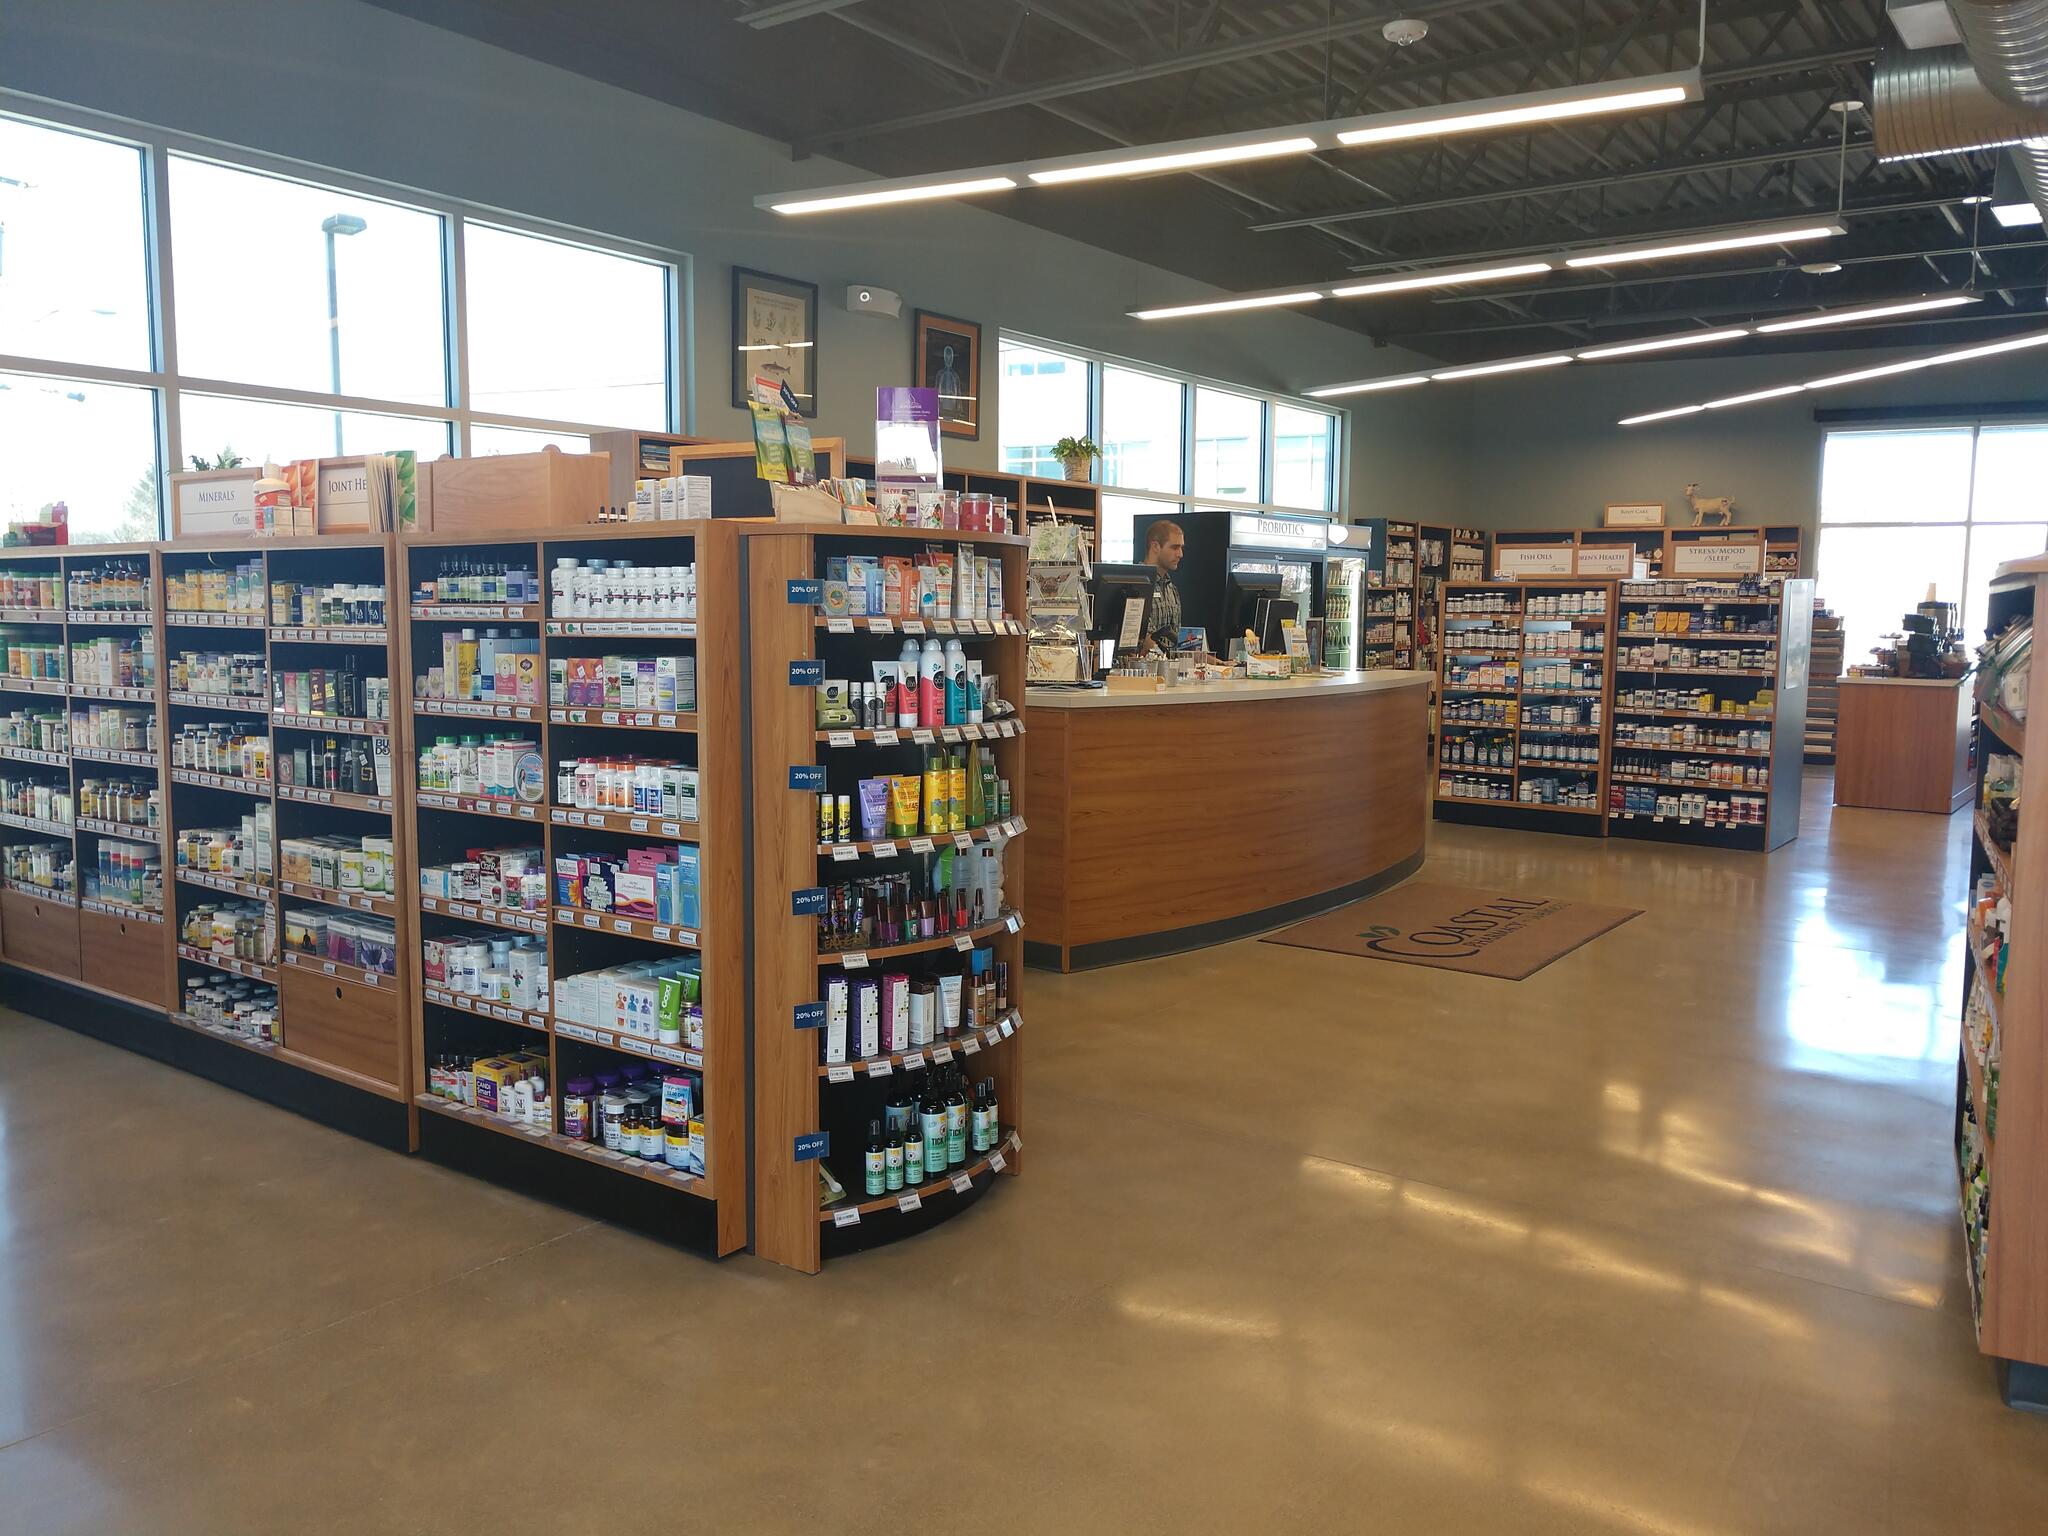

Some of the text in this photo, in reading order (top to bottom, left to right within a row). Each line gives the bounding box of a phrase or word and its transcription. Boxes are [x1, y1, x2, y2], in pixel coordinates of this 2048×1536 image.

[328, 480, 352, 495] JOINT
[198, 490, 235, 502] MINERALS
[1258, 518, 1305, 536] PROBIOTICS
[796, 896, 811, 904] 20%
[1366, 898, 1550, 957] COASTAL
[796, 1010, 824, 1020] 20% OFF
[798, 1140, 824, 1151] 20% OFF
